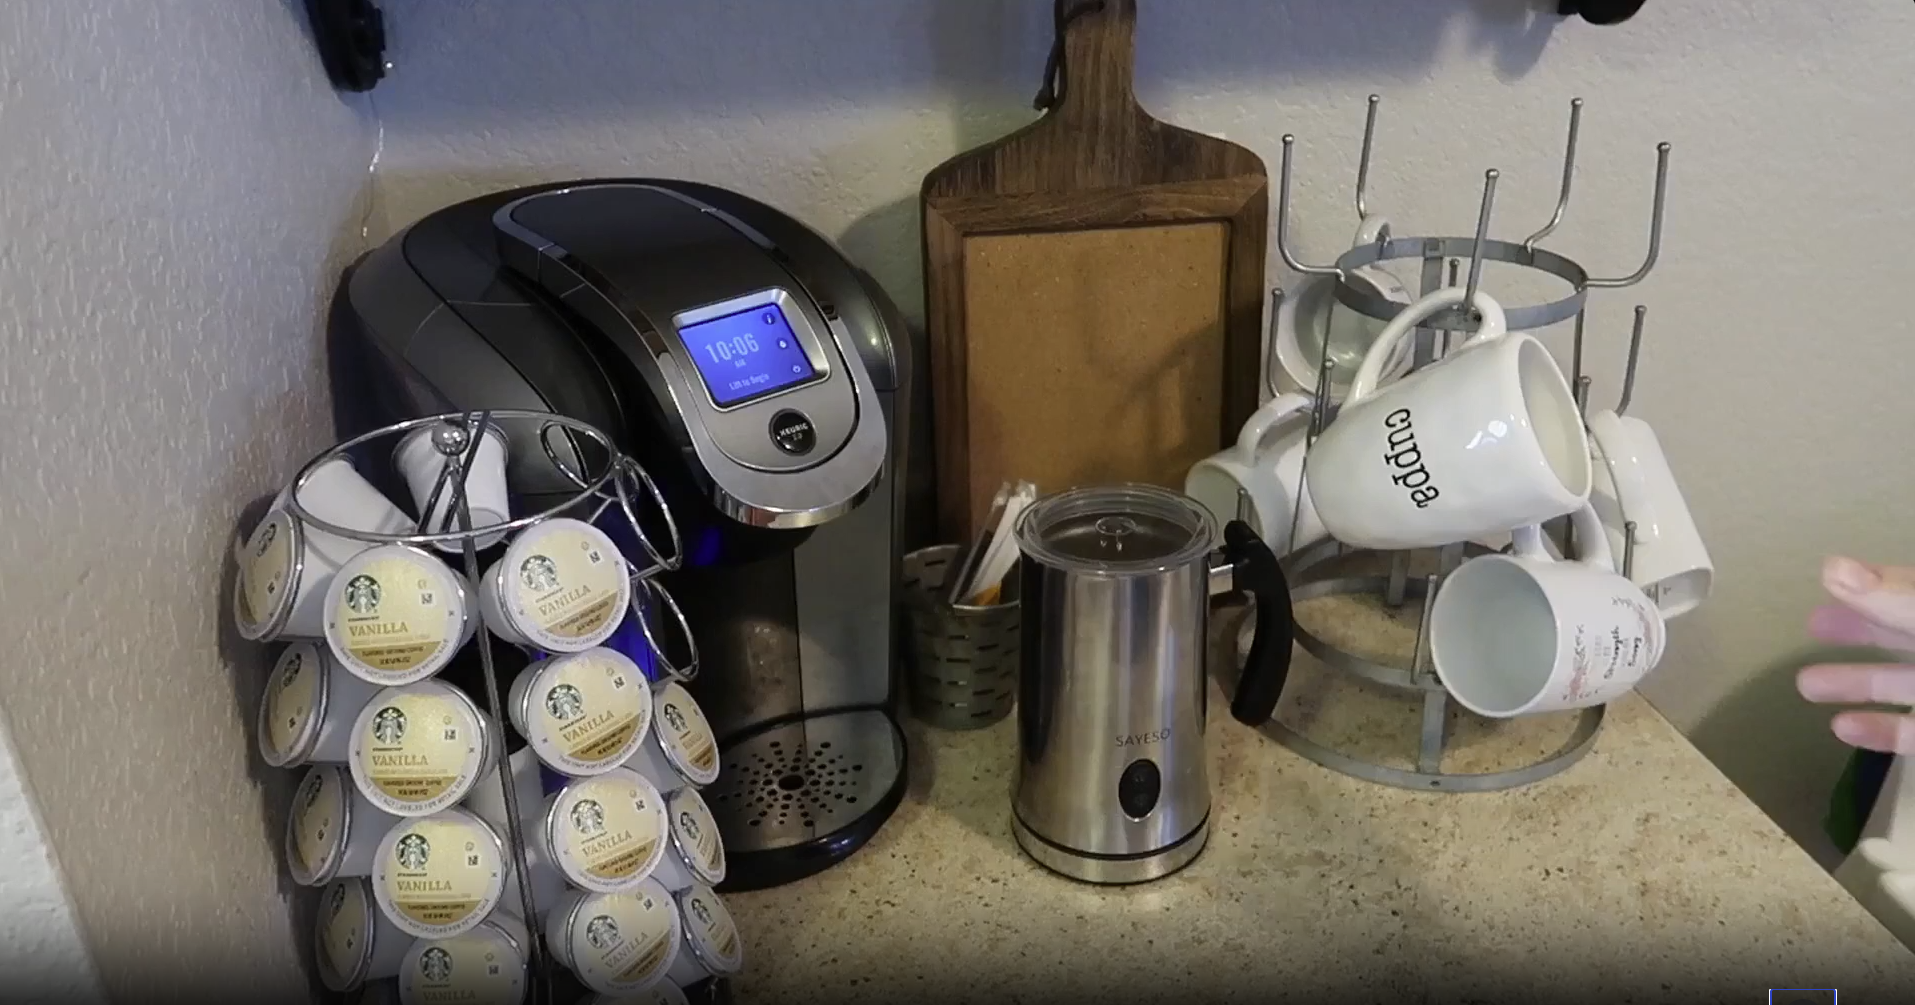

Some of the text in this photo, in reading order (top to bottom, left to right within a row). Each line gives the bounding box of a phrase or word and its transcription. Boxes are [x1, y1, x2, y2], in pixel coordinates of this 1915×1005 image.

[705, 333, 760, 363] 10:06
[779, 422, 808, 436] KEURIG
[1384, 408, 1440, 508] cuppa
[539, 584, 592, 616] VANILLA
[348, 621, 409, 637] VANILLA
[562, 710, 615, 742] VANILLA
[1115, 728, 1171, 747] SAYESO
[372, 754, 429, 766] VANILLA
[582, 829, 633, 857] VANILLA
[396, 880, 453, 892] VANILLA
[604, 932, 649, 968] VANILLA
[422, 988, 476, 1002] VANILLA
